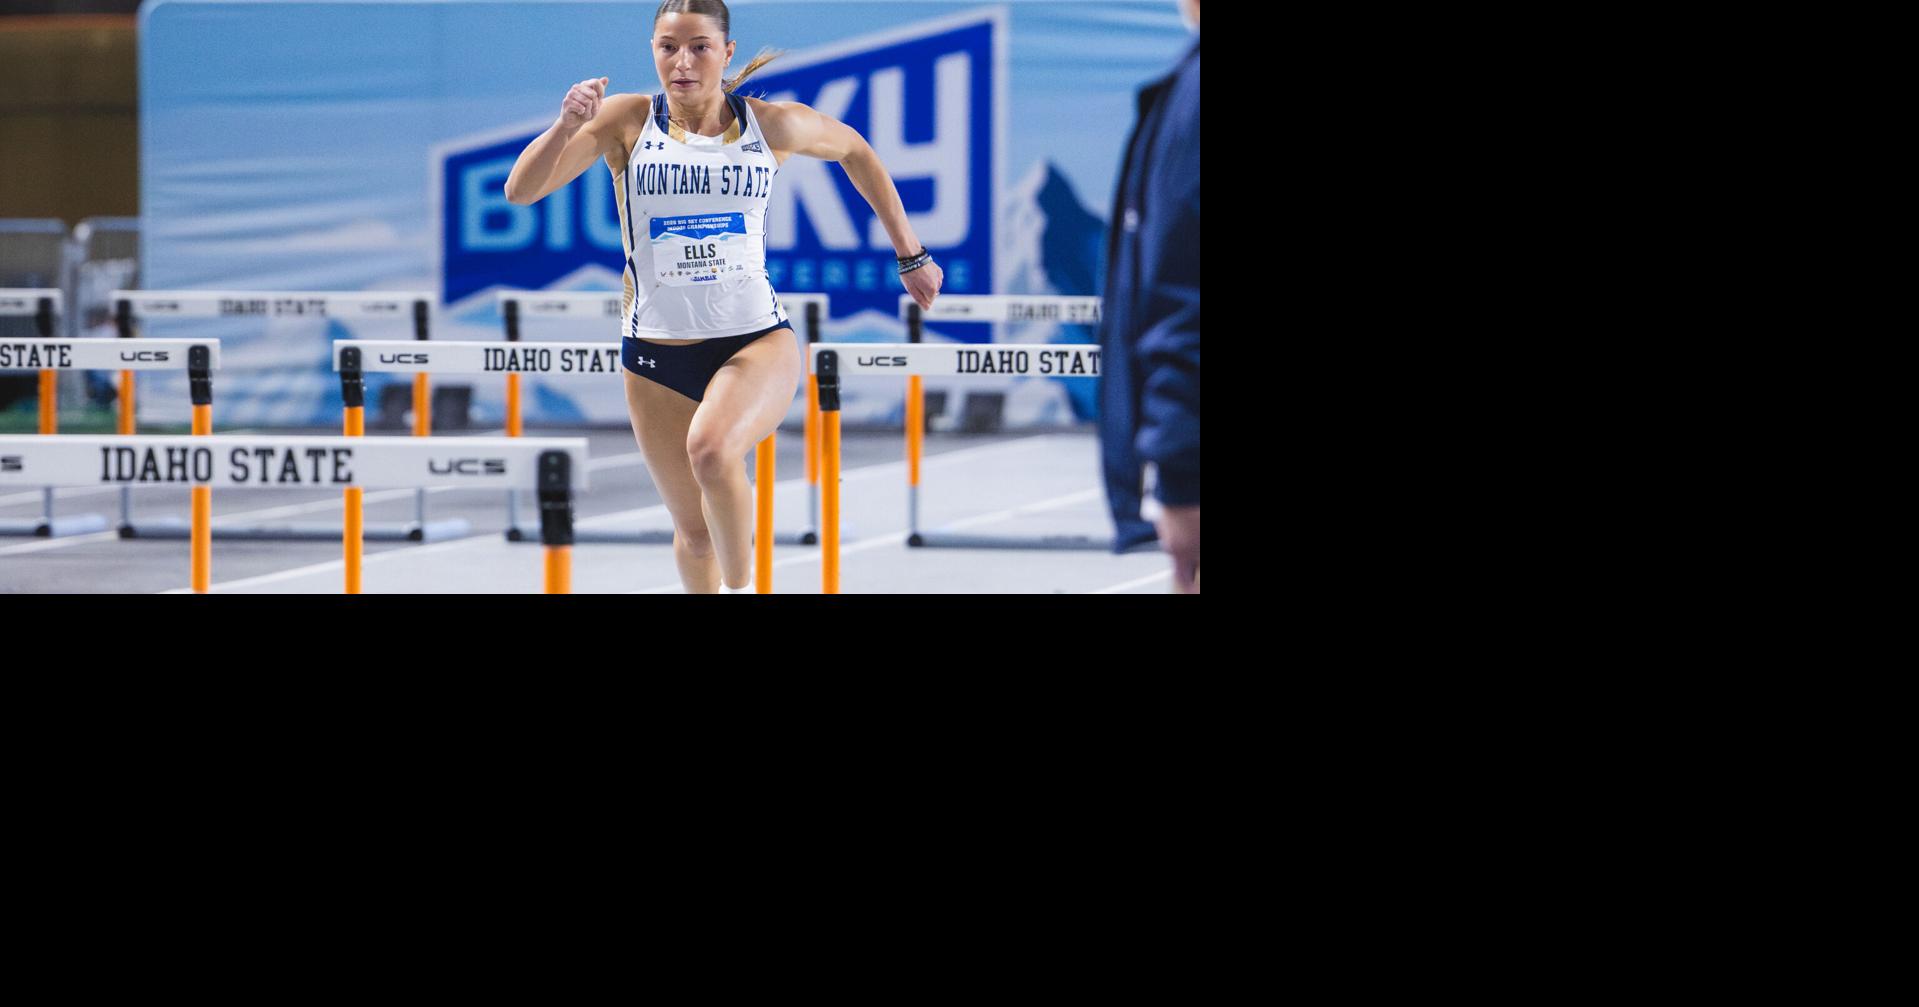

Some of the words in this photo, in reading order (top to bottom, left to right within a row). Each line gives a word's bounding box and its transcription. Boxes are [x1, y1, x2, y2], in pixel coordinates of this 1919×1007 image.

[637, 163, 711, 196] MONTANA
[721, 165, 769, 198] STATE
[684, 243, 716, 259] ELLS
[677, 261, 707, 269] MONTANA
[709, 258, 726, 267] STATE
[1067, 303, 1100, 323] STA
[0, 344, 71, 367] STATE
[120, 351, 168, 362] UCS
[380, 353, 429, 364] UCS
[484, 347, 551, 372] IDAHO
[561, 348, 622, 373] STAT
[858, 356, 907, 367] UCS
[957, 351, 1028, 374] IDAHO
[1040, 351, 1100, 375] STAT
[101, 446, 213, 482] IDAHO
[230, 447, 353, 484] STATE
[428, 458, 507, 475] UCS
